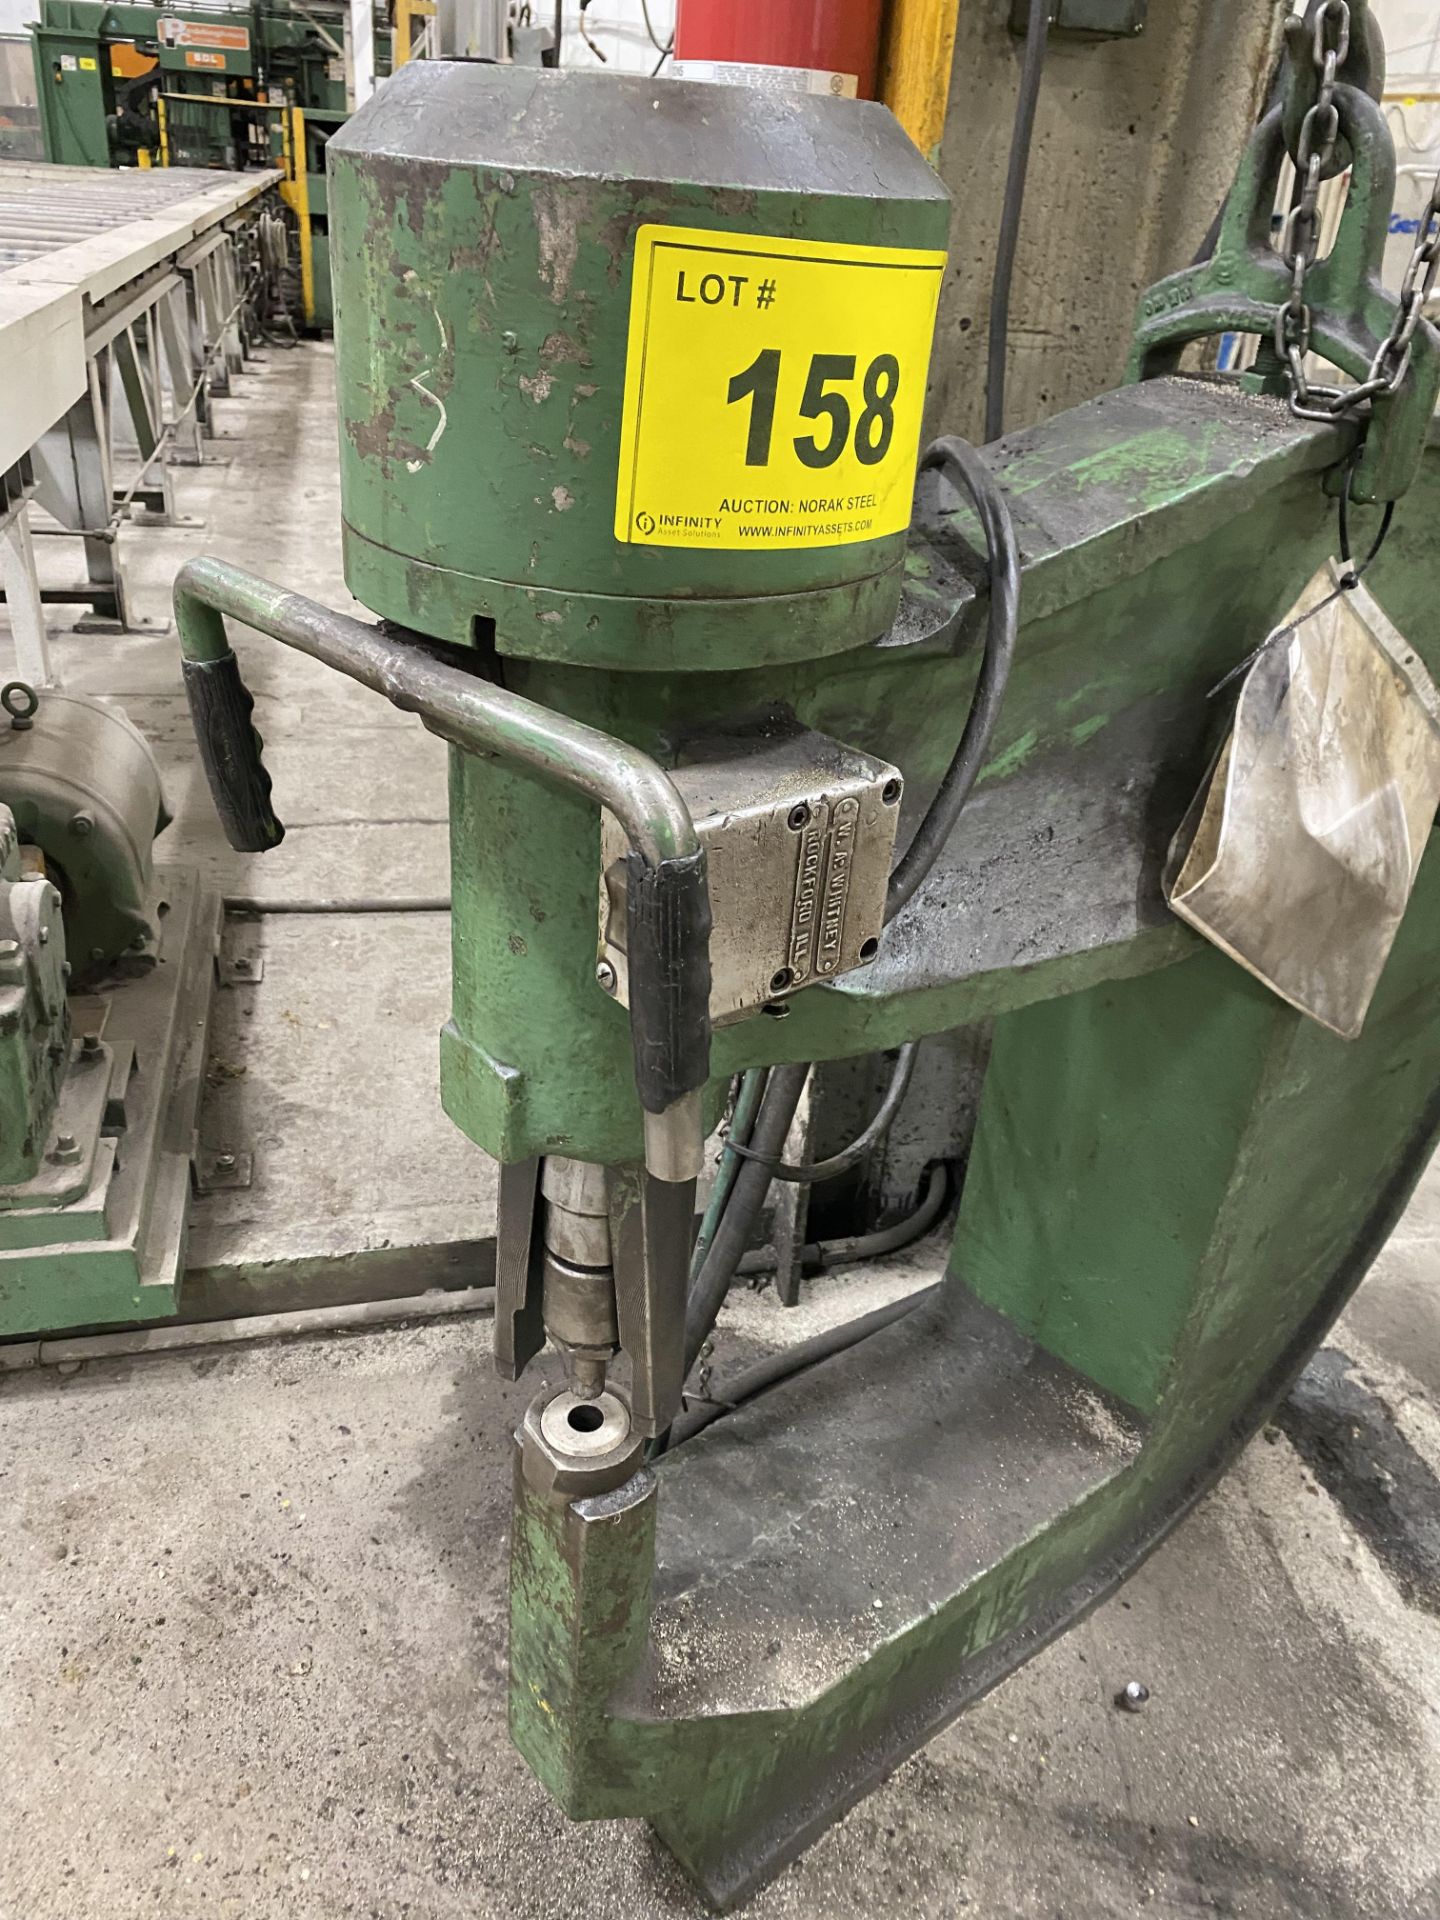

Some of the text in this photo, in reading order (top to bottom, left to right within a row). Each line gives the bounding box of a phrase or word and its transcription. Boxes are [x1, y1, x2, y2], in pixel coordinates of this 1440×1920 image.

[676, 270, 777, 310] LOT #
[726, 348, 900, 469] 158
[718, 493, 878, 514] AUCTION: NORAK STEEL
[656, 527, 721, 539] Asset Solutions
[659, 514, 722, 529] INFINITY
[737, 518, 874, 538] WWW.INFINITYASSETS.COM
[793, 829, 821, 963] ROCKFORD ILL
[824, 873, 845, 950] WHITNEY
